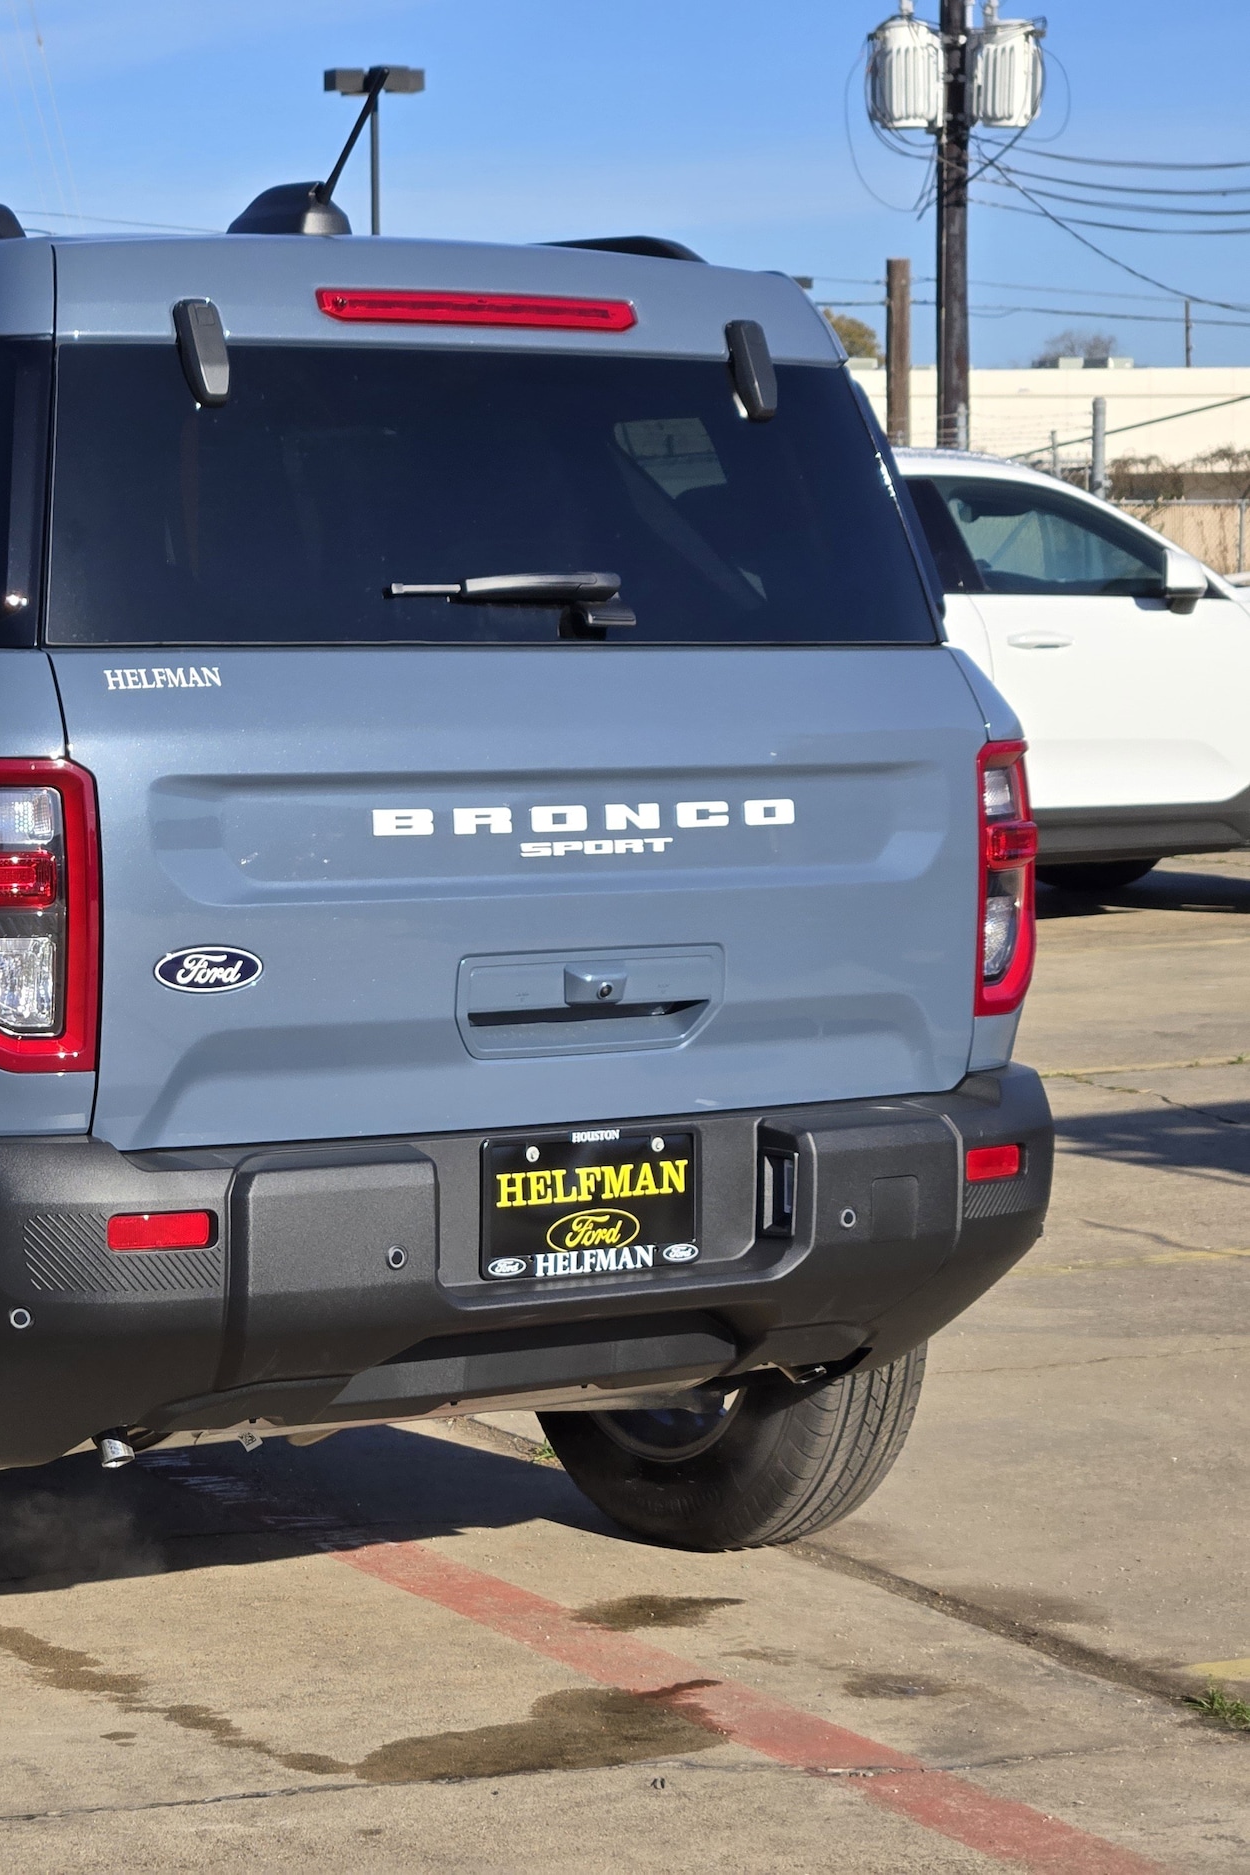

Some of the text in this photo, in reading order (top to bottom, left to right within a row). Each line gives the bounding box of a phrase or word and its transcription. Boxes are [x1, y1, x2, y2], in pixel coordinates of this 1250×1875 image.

[103, 667, 222, 690] HELFMAN
[372, 798, 796, 836] BRONCO
[519, 837, 673, 857] SPORT
[176, 954, 244, 984] Ford
[571, 1129, 620, 1143] HOUSTON
[496, 1159, 688, 1208] HELFMAN
[564, 1215, 623, 1248] Ford
[535, 1245, 656, 1277] HELFMAN
